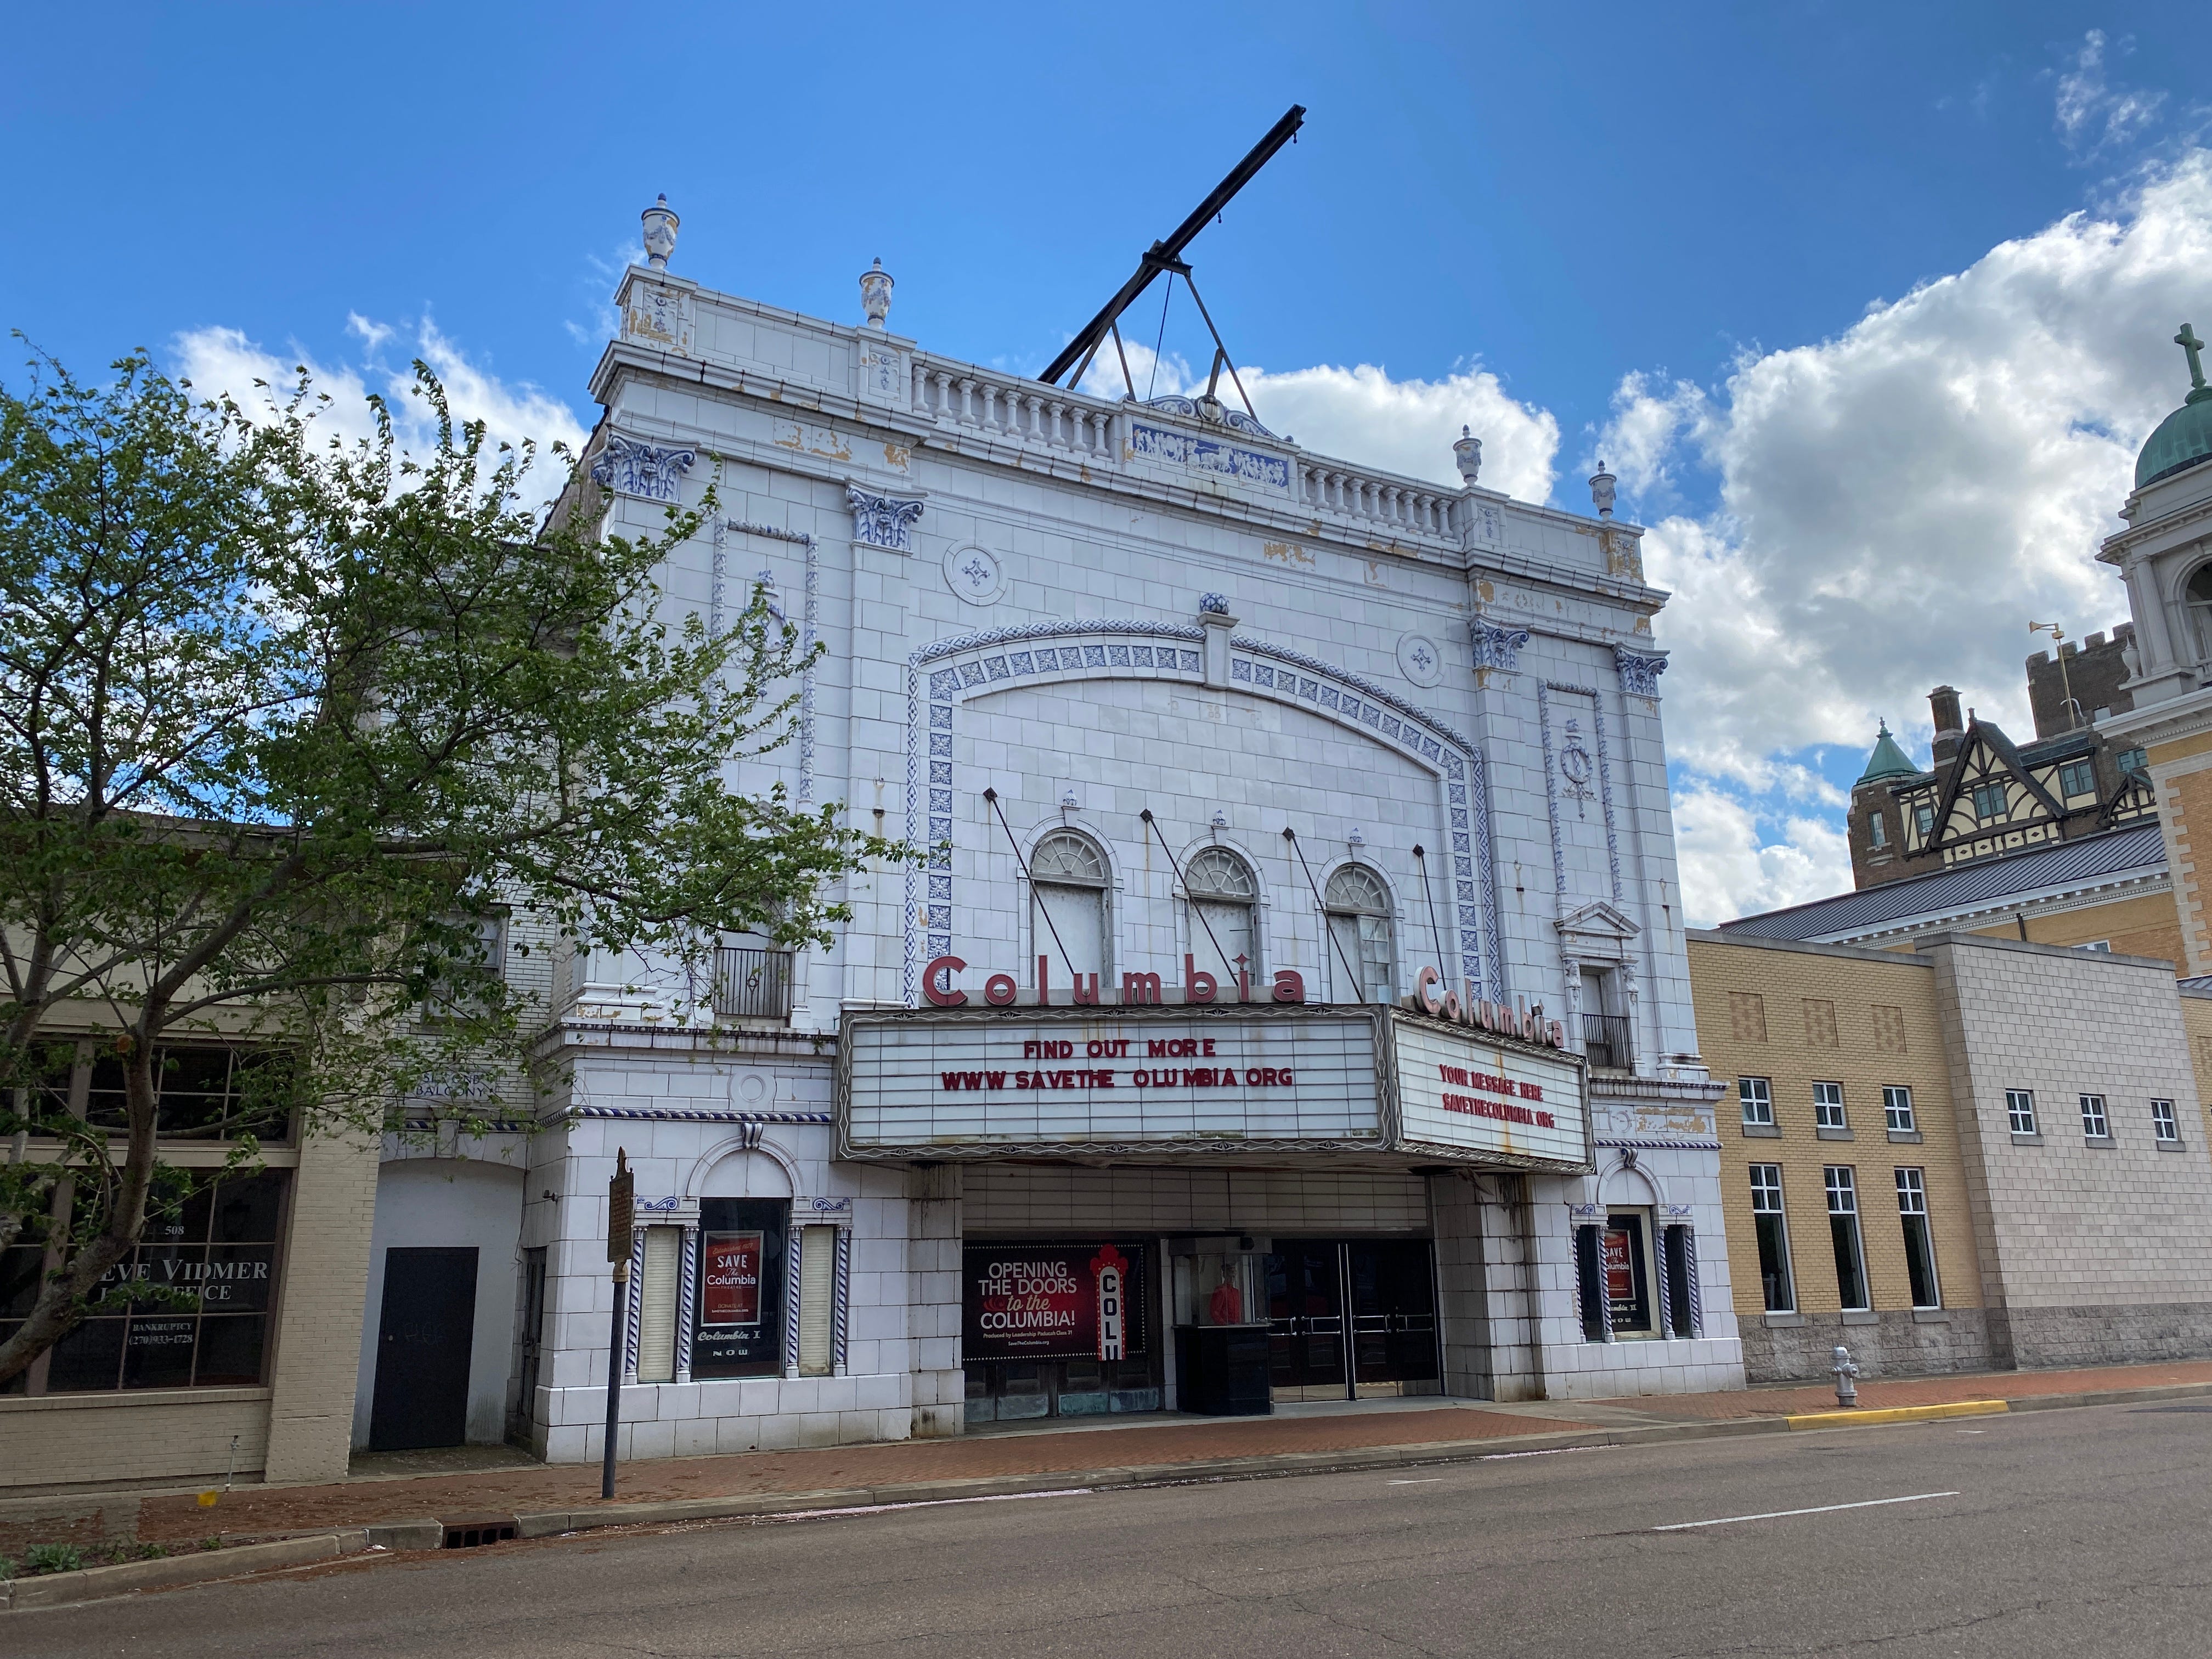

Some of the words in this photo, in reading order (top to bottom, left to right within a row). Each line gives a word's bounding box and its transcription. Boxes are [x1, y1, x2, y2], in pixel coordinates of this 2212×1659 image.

[922, 954, 1305, 1007] Columbia
[1413, 966, 1564, 1048] Columbia
[1024, 1040, 1073, 1059] FIND
[1087, 1040, 1130, 1058] OUT
[1148, 1039, 1216, 1058] MORE
[941, 1070, 1006, 1090] WWW
[1015, 1069, 1114, 1089] SAVETHE
[1246, 1068, 1292, 1086] ORG
[1440, 1064, 1468, 1086] YOUR
[1472, 1072, 1515, 1096] MESSAGE
[1520, 1082, 1543, 1102] HERE
[1442, 1093, 1532, 1125] SAVETHECOLUMBIA
[1536, 1111, 1554, 1128] ORG
[165, 1225, 184, 1235] 508
[1605, 1248, 1623, 1258] SAVE
[717, 1255, 748, 1268] SAVE
[1606, 1261, 1629, 1270] olumbia
[98, 1263, 151, 1282] EVE
[725, 1268, 738, 1276] The
[989, 1262, 1067, 1279] OPENING
[707, 1273, 756, 1285] Columbia
[978, 1279, 1012, 1295] THE
[1018, 1278, 1077, 1294] DOORS
[1006, 1296, 1024, 1311] to
[1026, 1295, 1051, 1311] the
[132, 1323, 193, 1331] BANKRUPTCY
[980, 1311, 1075, 1329] COLUMBIA!
[697, 1330, 750, 1341] Columbia
[753, 1330, 761, 1339] I
[713, 1348, 748, 1357] NOW
